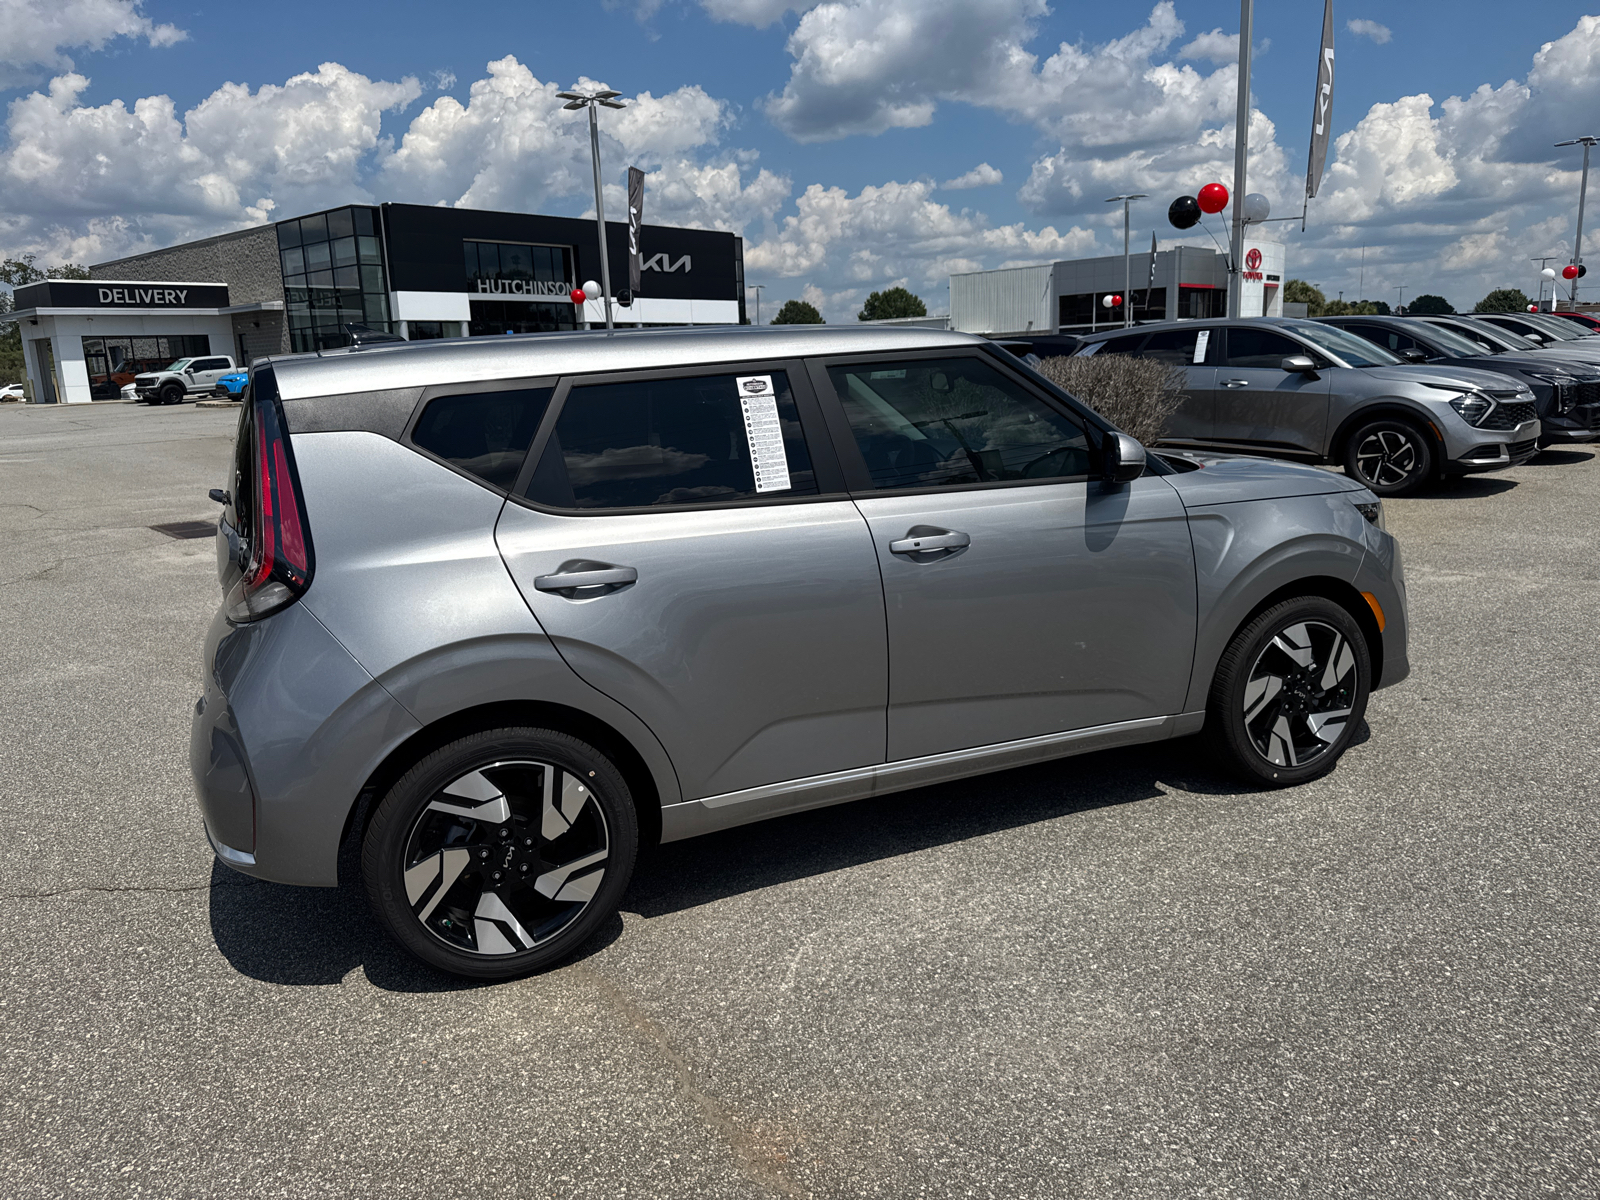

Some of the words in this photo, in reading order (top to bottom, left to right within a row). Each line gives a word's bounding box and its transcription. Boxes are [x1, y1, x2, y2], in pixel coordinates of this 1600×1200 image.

[639, 252, 692, 274] KIA
[1242, 271, 1263, 280] TOYOTA
[477, 279, 575, 296] HUTCHINSON
[98, 288, 188, 304] DELIVERY
